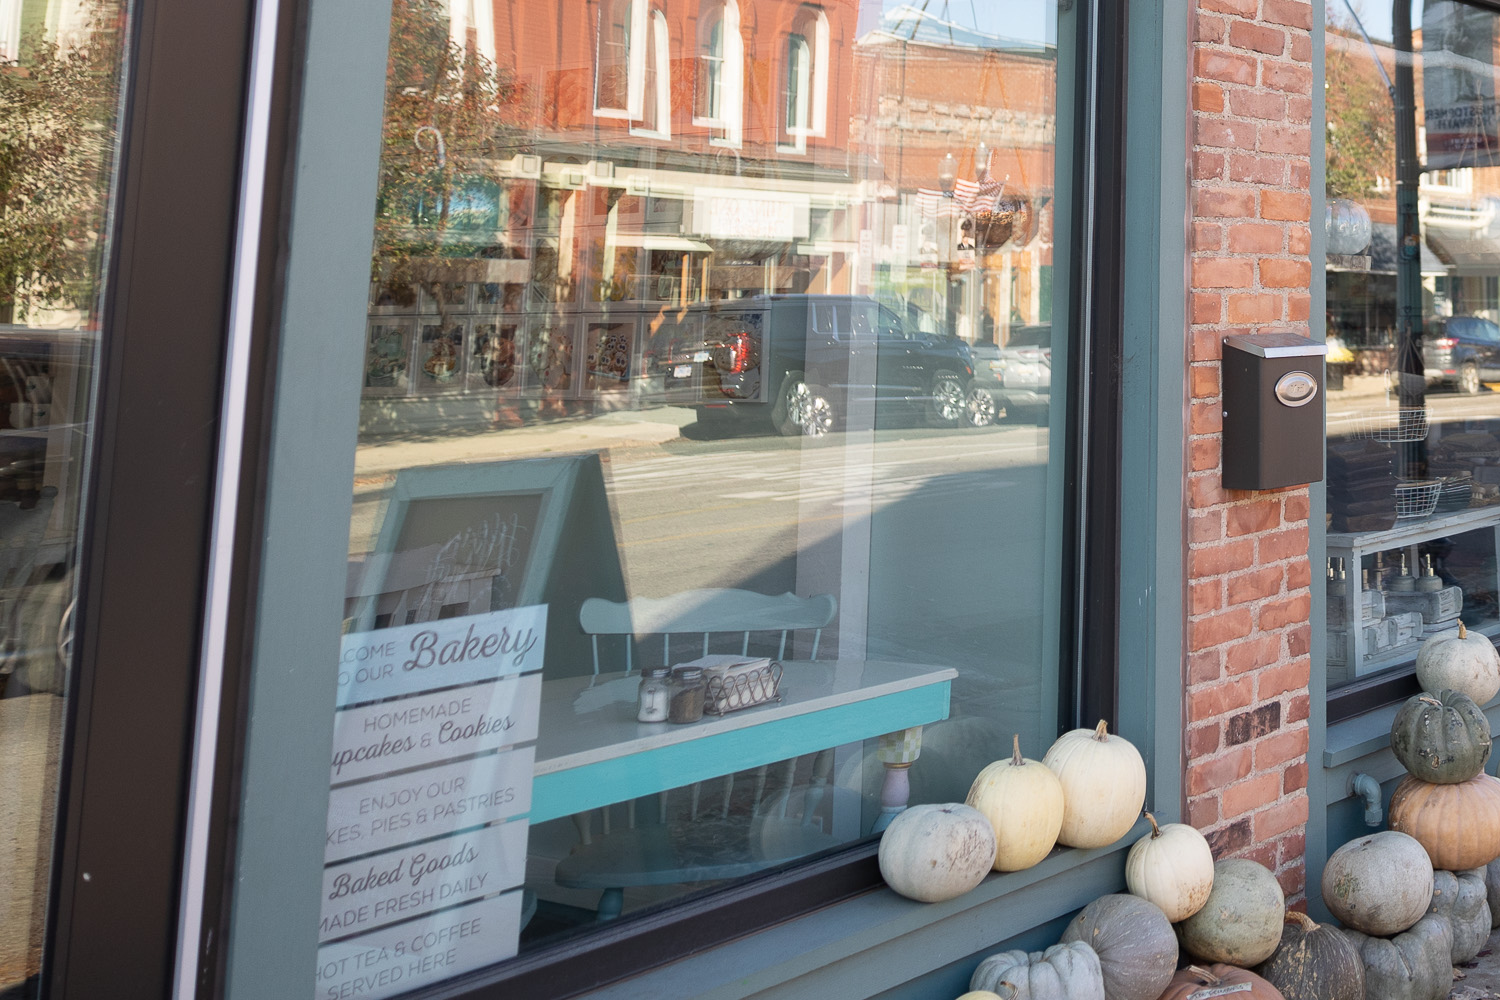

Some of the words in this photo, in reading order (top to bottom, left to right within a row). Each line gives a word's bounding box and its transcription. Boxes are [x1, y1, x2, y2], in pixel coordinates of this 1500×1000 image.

[402, 624, 537, 671] Bakery
[355, 663, 394, 683] OUR
[363, 696, 472, 733] HOMEMADE
[420, 732, 432, 748] &
[438, 714, 516, 746] Cookies
[359, 787, 422, 816] ENJOY
[427, 777, 464, 801] OUR
[371, 811, 410, 837] PIES
[416, 809, 427, 824] &
[433, 787, 514, 819] PASTRIES
[329, 860, 402, 900] Baked
[409, 842, 479, 886] Goods
[374, 891, 434, 918] FRESH
[439, 873, 488, 899] DAILY
[352, 947, 389, 969] TEA
[394, 941, 405, 955] &
[411, 918, 482, 952] COFFEE
[328, 966, 403, 1000] SERVED
[408, 948, 457, 977] HERE
